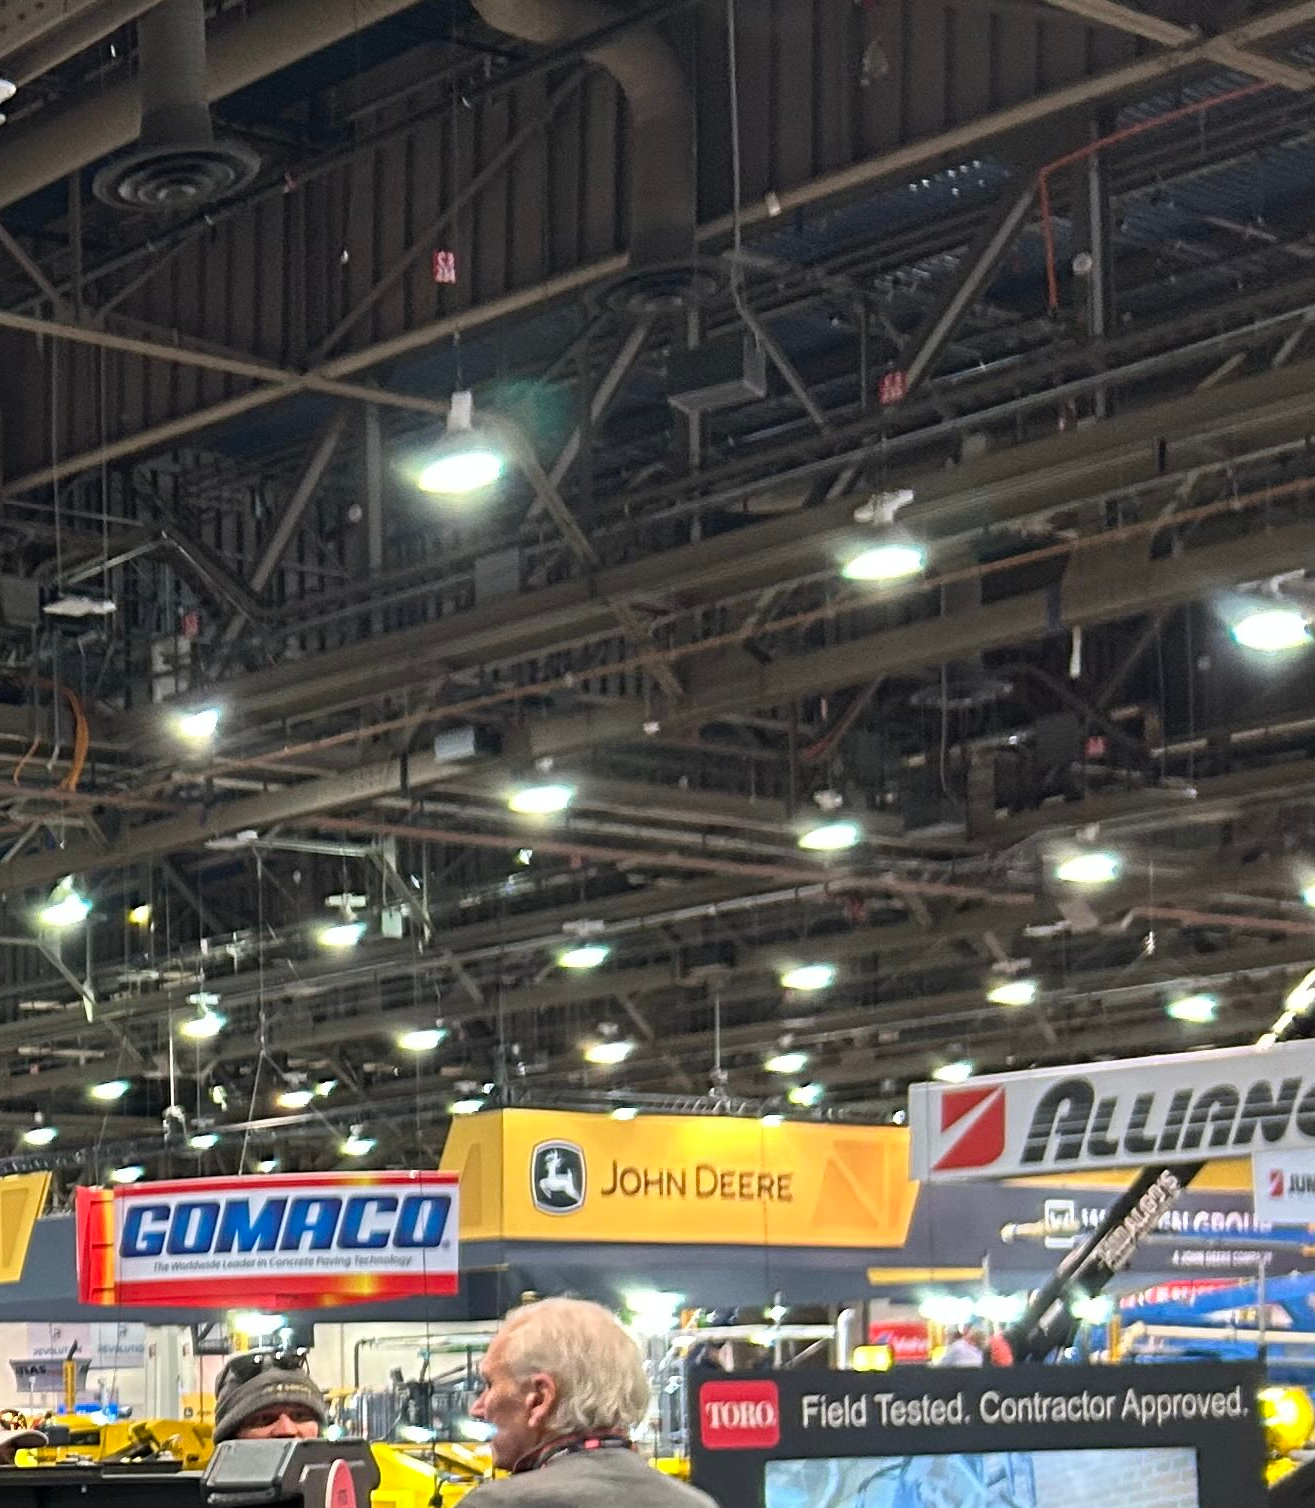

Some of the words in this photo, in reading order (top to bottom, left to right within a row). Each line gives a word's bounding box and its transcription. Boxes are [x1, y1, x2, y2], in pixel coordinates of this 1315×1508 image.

[601, 1159, 686, 1198] JOHN
[695, 1163, 794, 1202] DEERE
[120, 1196, 451, 1258] GOMACO
[154, 1261, 169, 1272] The
[223, 1258, 255, 1269] Leader
[257, 1257, 267, 1267] in
[269, 1255, 314, 1267] Concrete
[355, 1253, 412, 1267] Technology
[705, 1400, 775, 1430] TORO
[801, 1393, 867, 1428] Field
[874, 1391, 970, 1428] Tested.
[979, 1389, 1116, 1424] Contractor
[1122, 1385, 1249, 1427] Approved.
